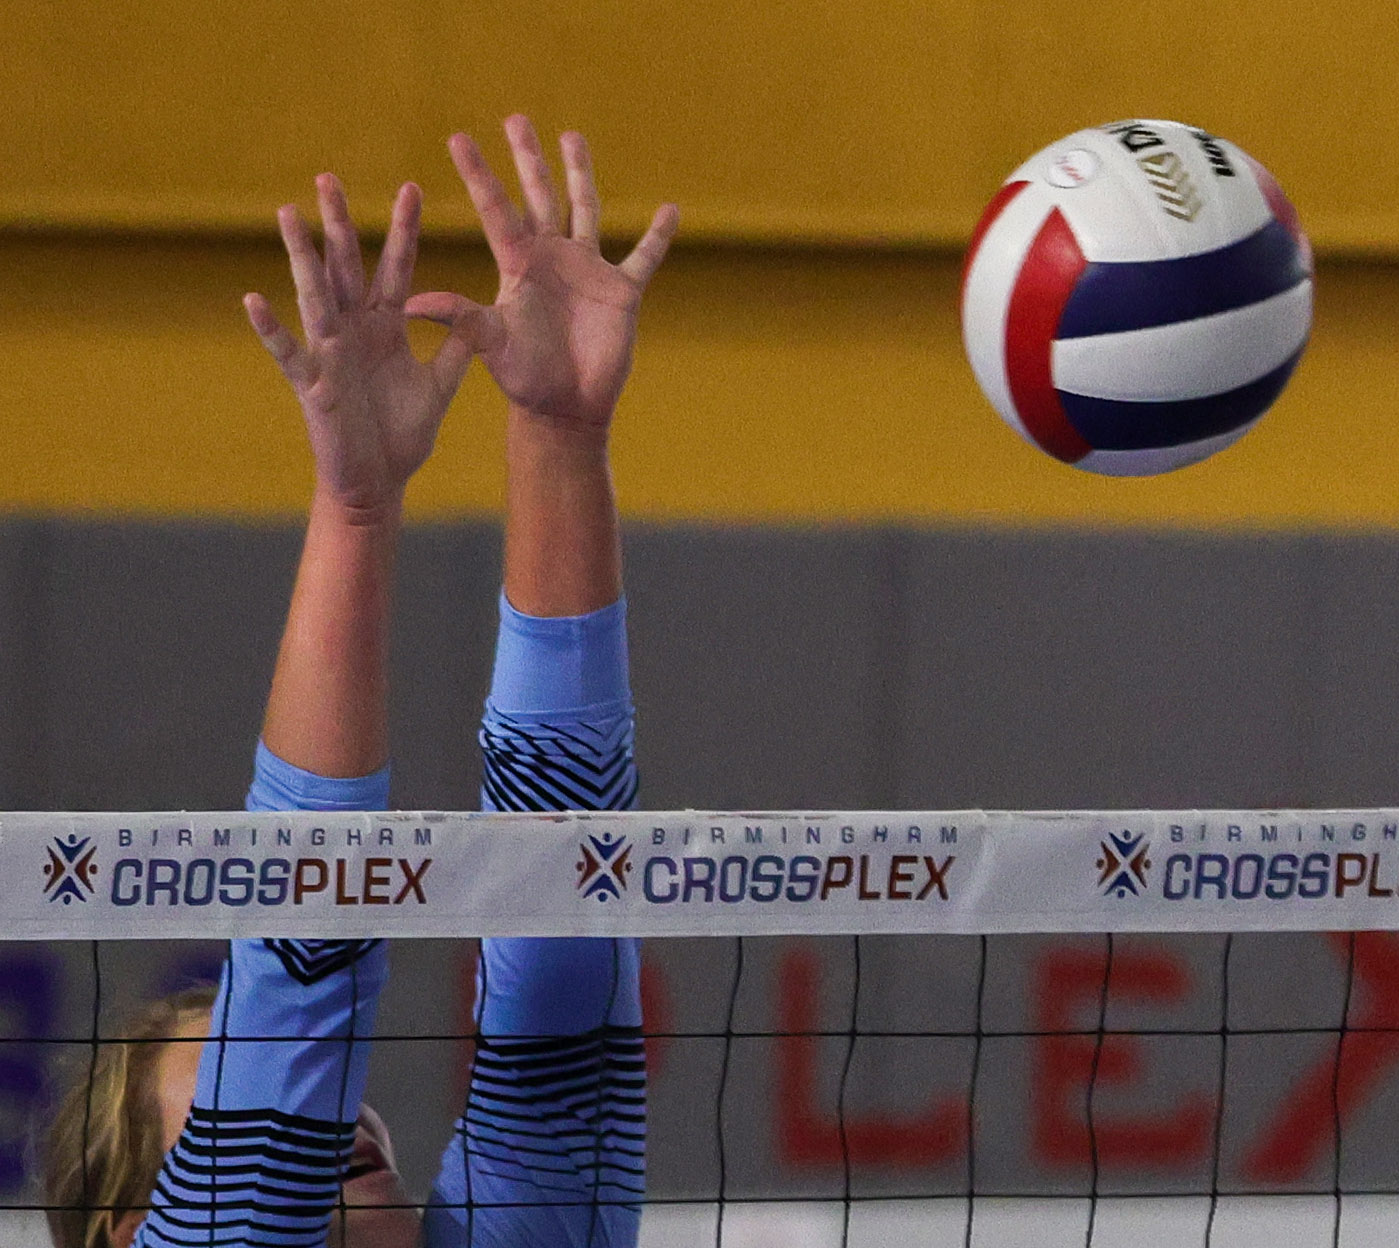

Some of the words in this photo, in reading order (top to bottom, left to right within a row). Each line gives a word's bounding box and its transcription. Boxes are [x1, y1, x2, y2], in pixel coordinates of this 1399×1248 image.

[118, 827, 432, 848] BIRMINGHAM
[651, 825, 958, 846] BIRMINGHAM
[111, 857, 432, 907] CROSSPLEX
[643, 854, 957, 904] CROSSPLEX
